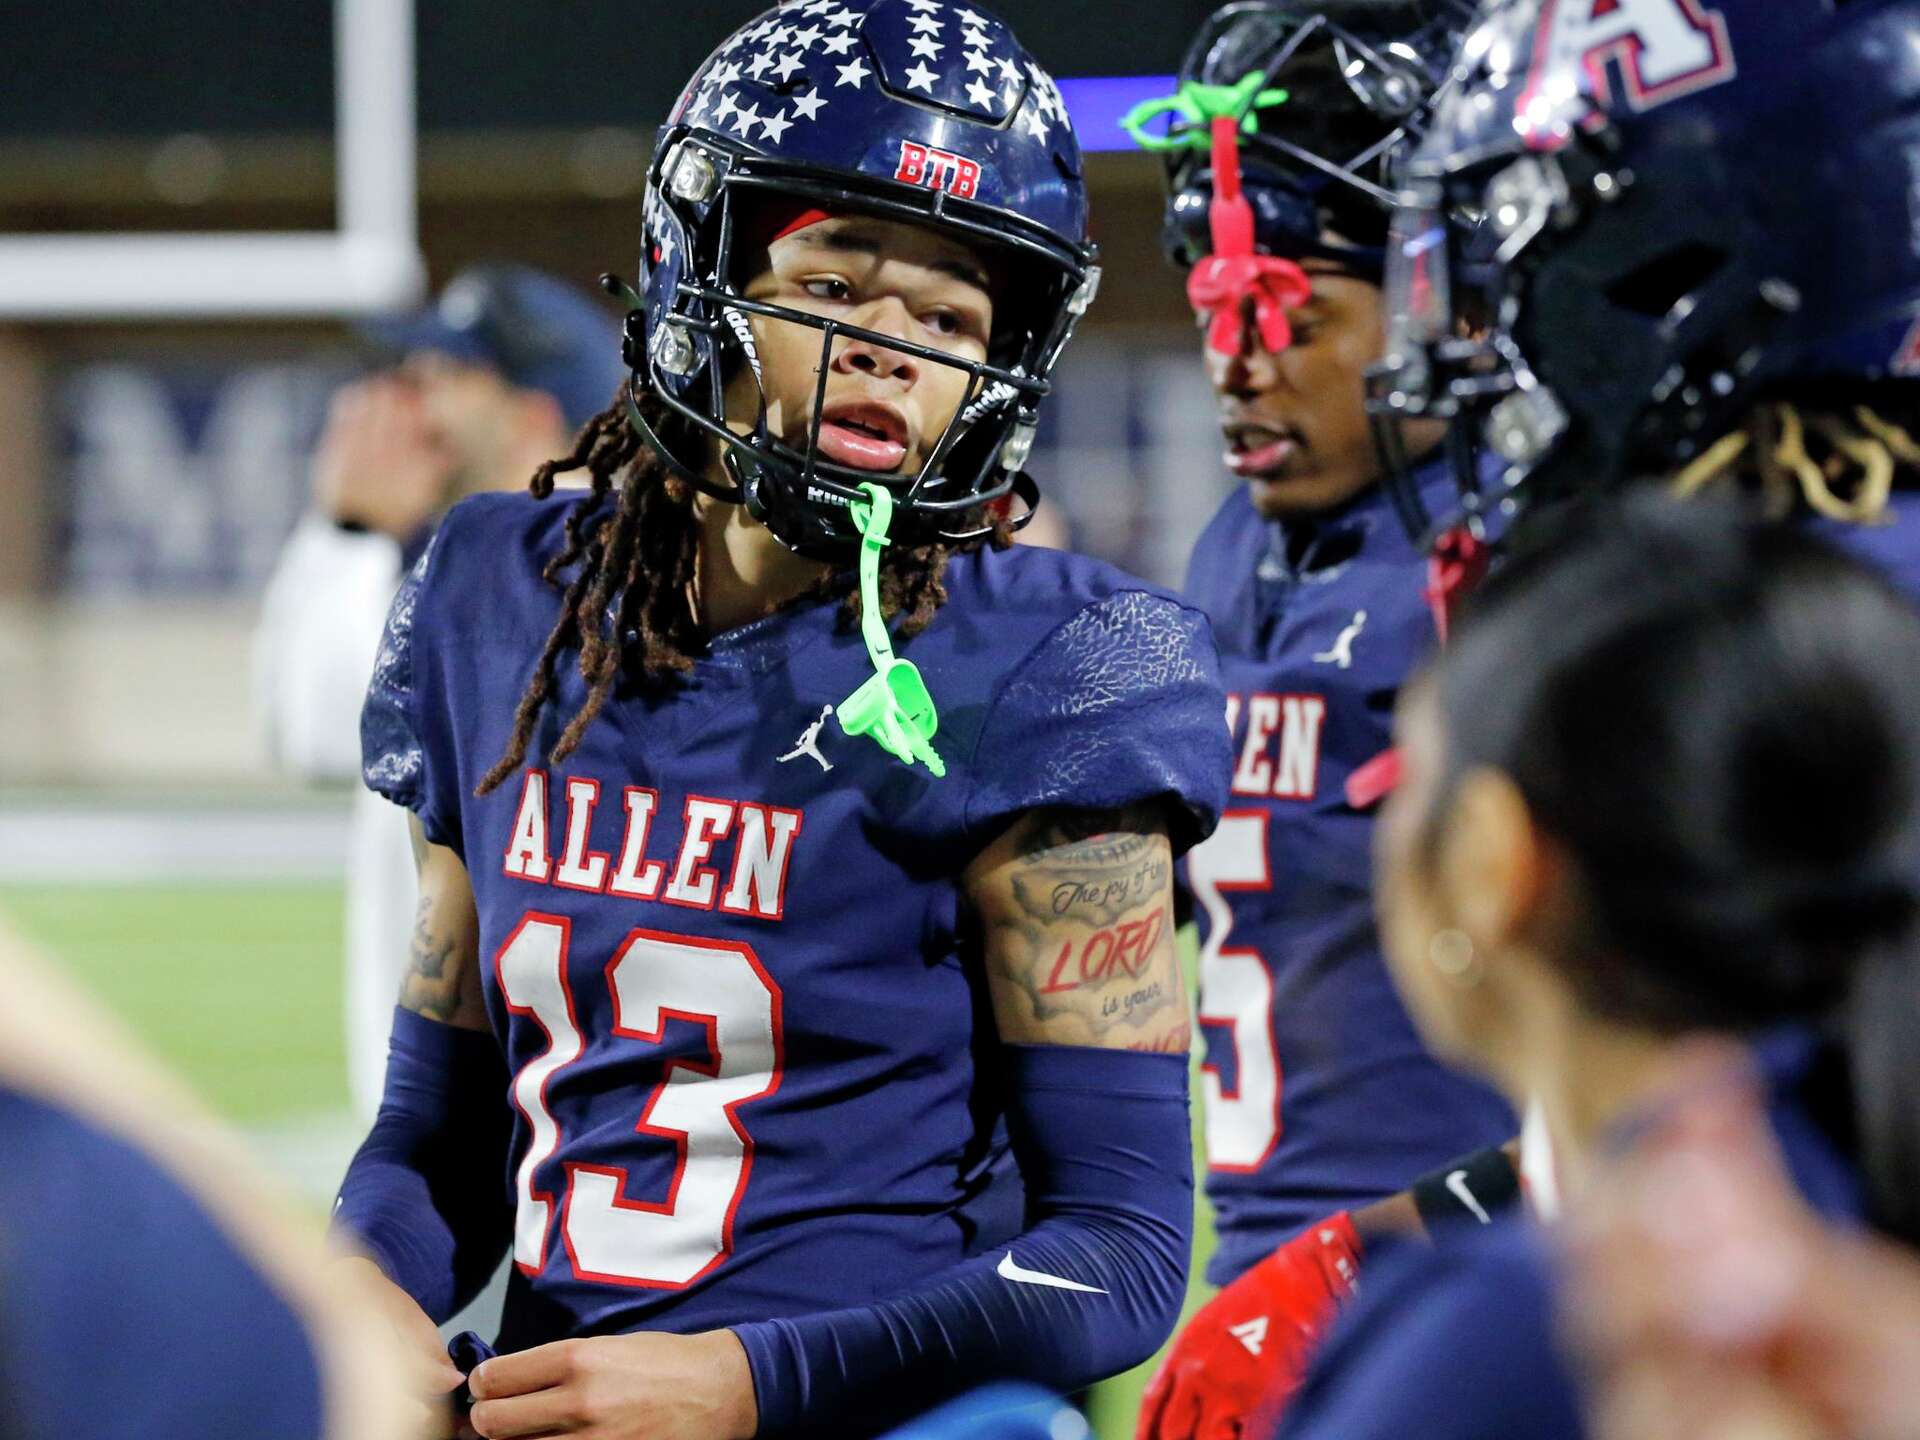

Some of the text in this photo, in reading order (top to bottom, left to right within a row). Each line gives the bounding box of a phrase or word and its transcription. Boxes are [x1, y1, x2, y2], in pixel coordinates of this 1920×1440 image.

[894, 139, 982, 200] BTB
[503, 767, 802, 920] ALLEN
[1052, 880, 1101, 914] The
[1098, 877, 1130, 906] joy
[1038, 906, 1166, 995] LORD
[495, 911, 783, 1289] 13
